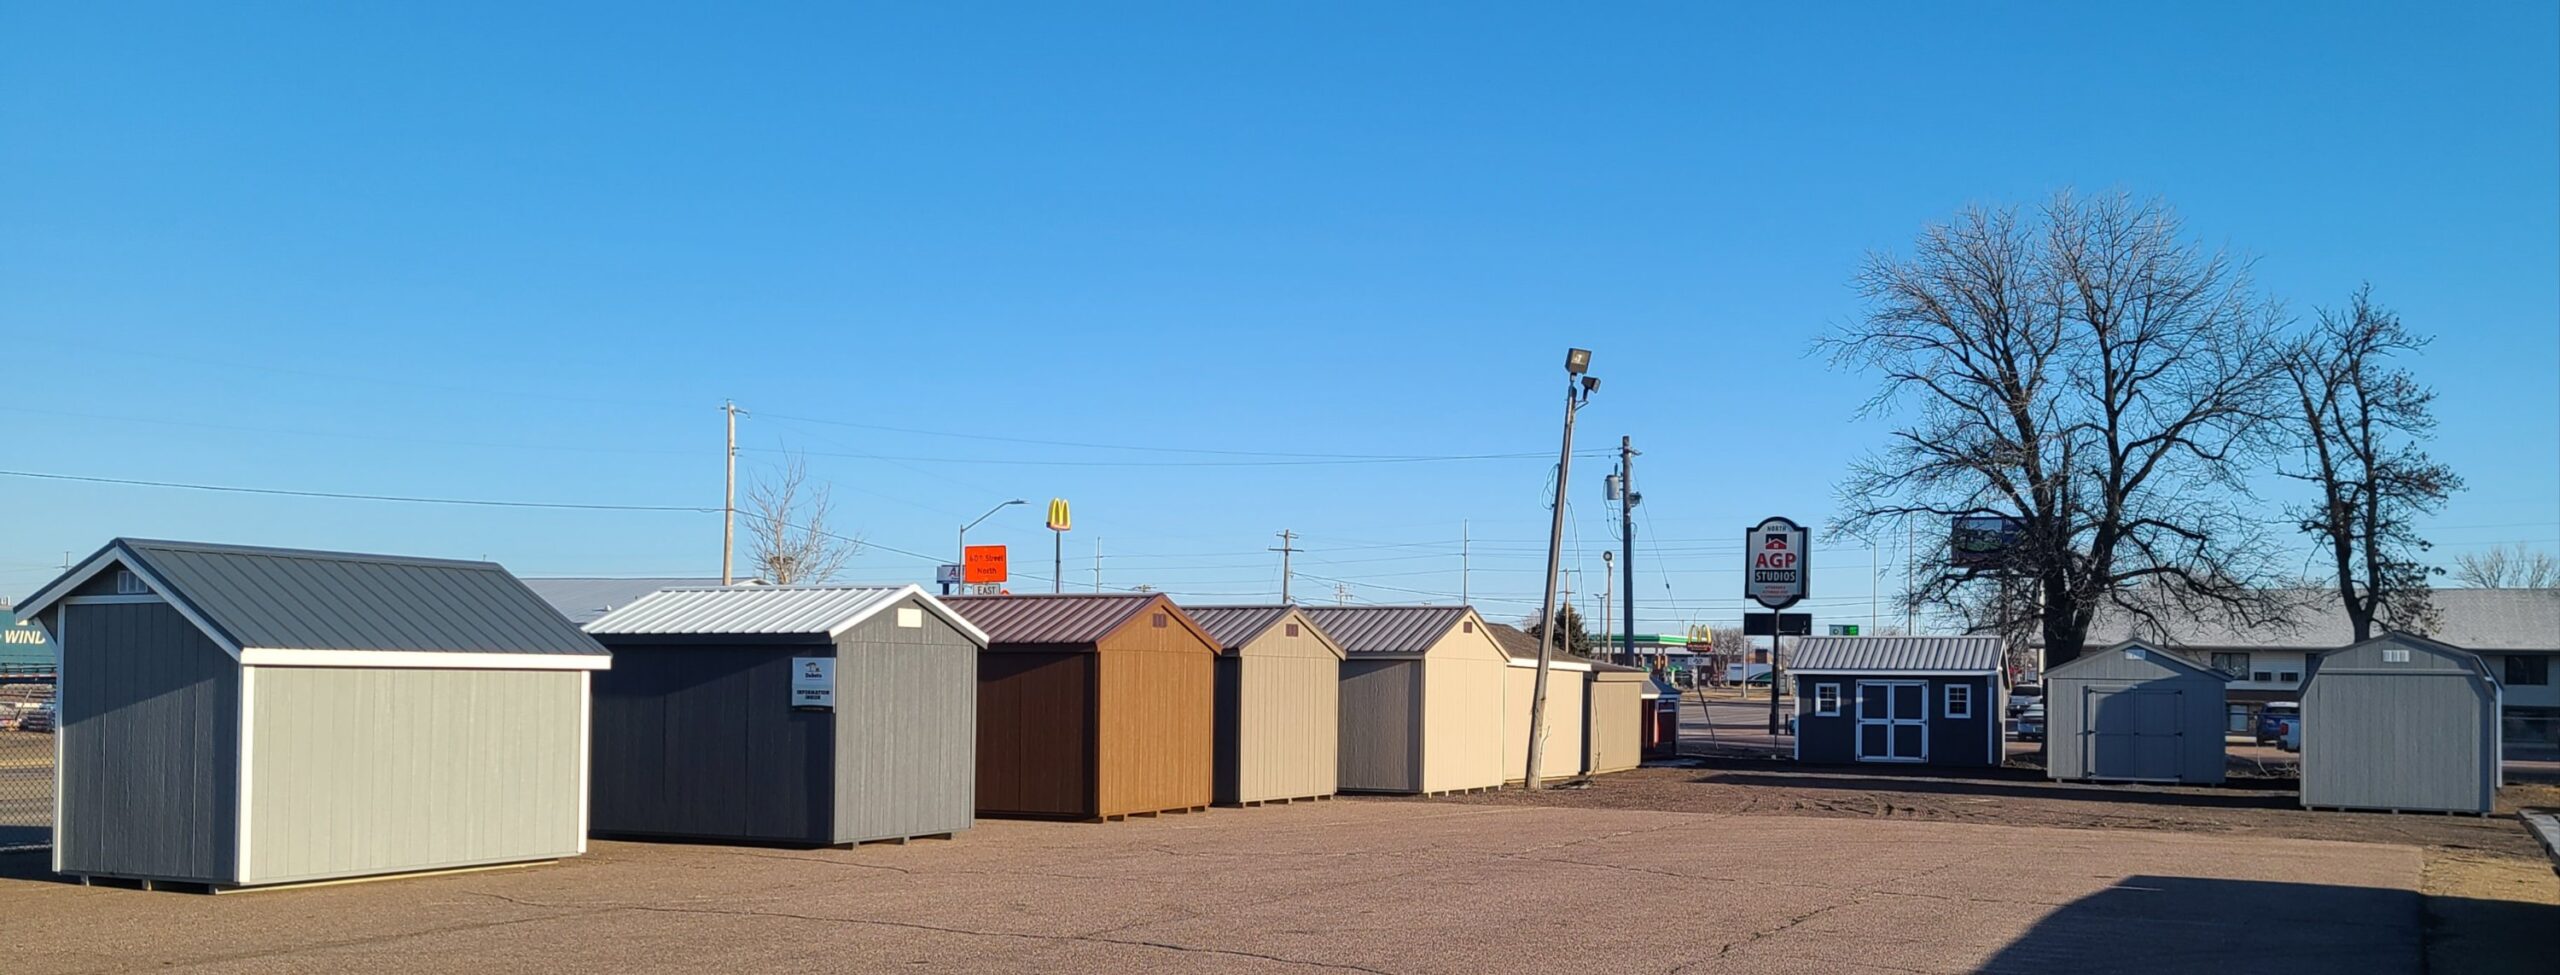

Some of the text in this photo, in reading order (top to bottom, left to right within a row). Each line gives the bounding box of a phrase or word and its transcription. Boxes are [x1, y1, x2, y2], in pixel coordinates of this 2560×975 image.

[1755, 552, 1797, 569] AGP
[977, 567, 997, 575] North
[1755, 571, 1796, 581] STUDIOS
[977, 586, 996, 595] EAST
